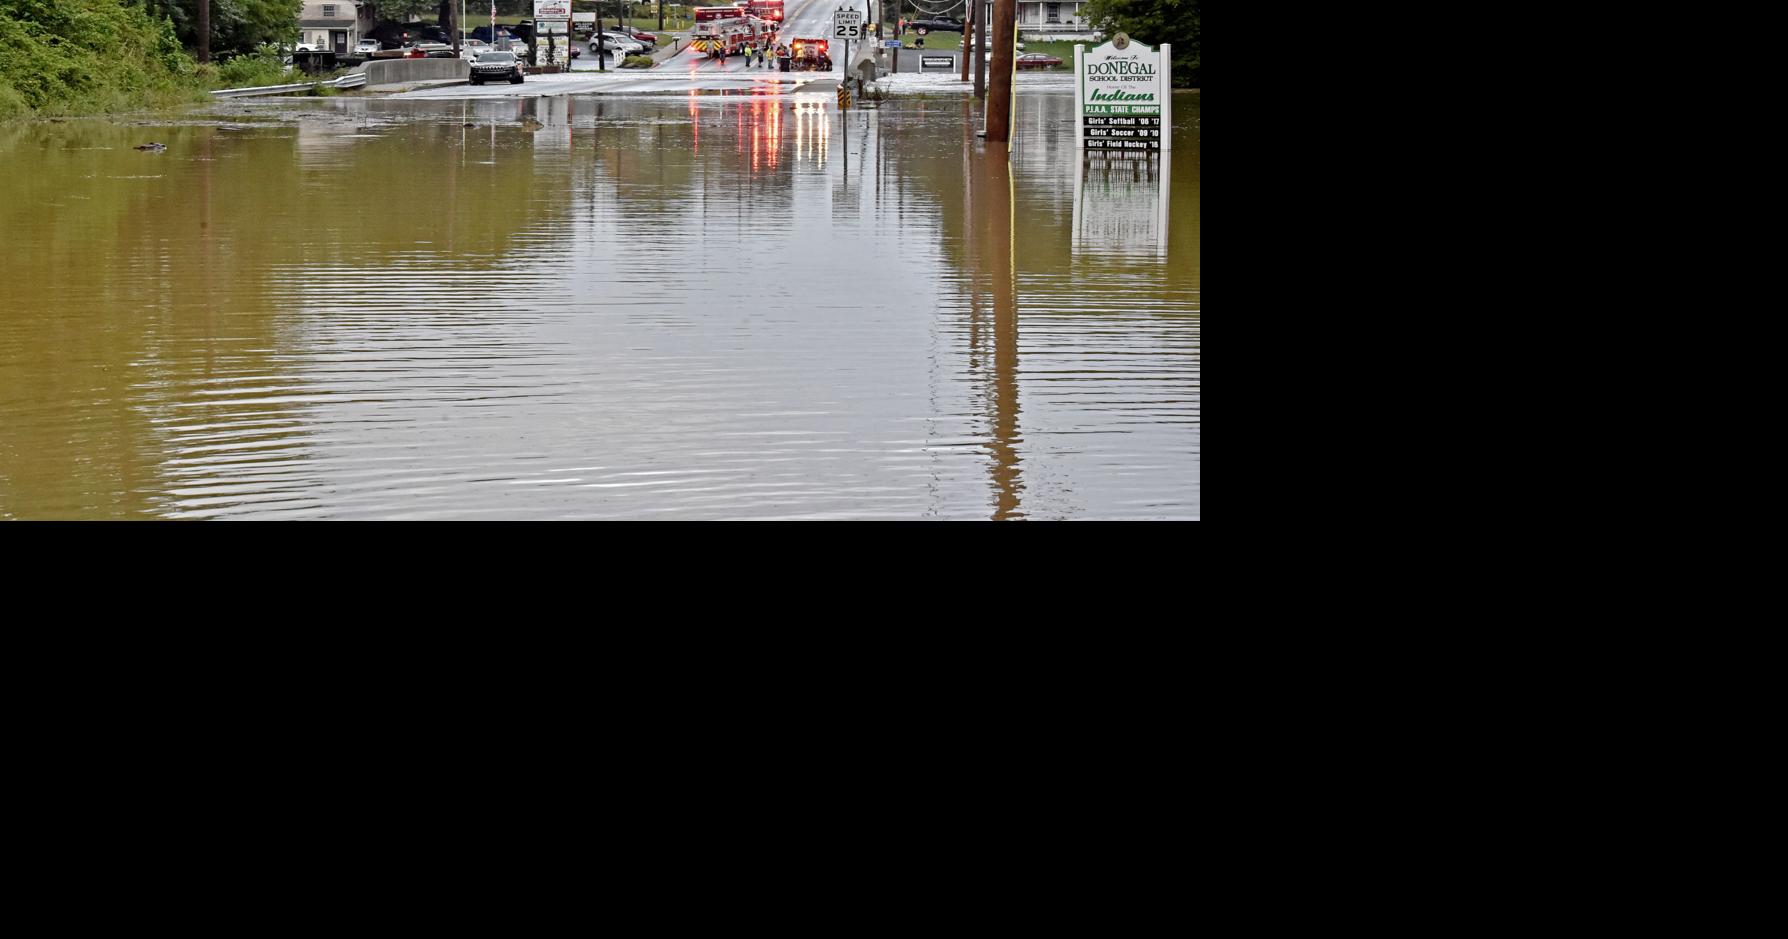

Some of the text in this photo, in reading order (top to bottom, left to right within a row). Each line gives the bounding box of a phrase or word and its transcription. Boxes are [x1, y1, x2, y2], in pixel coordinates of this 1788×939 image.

[836, 26, 858, 36] 25
[1088, 61, 1156, 74] DONEGAL
[1090, 88, 1154, 101] Indians
